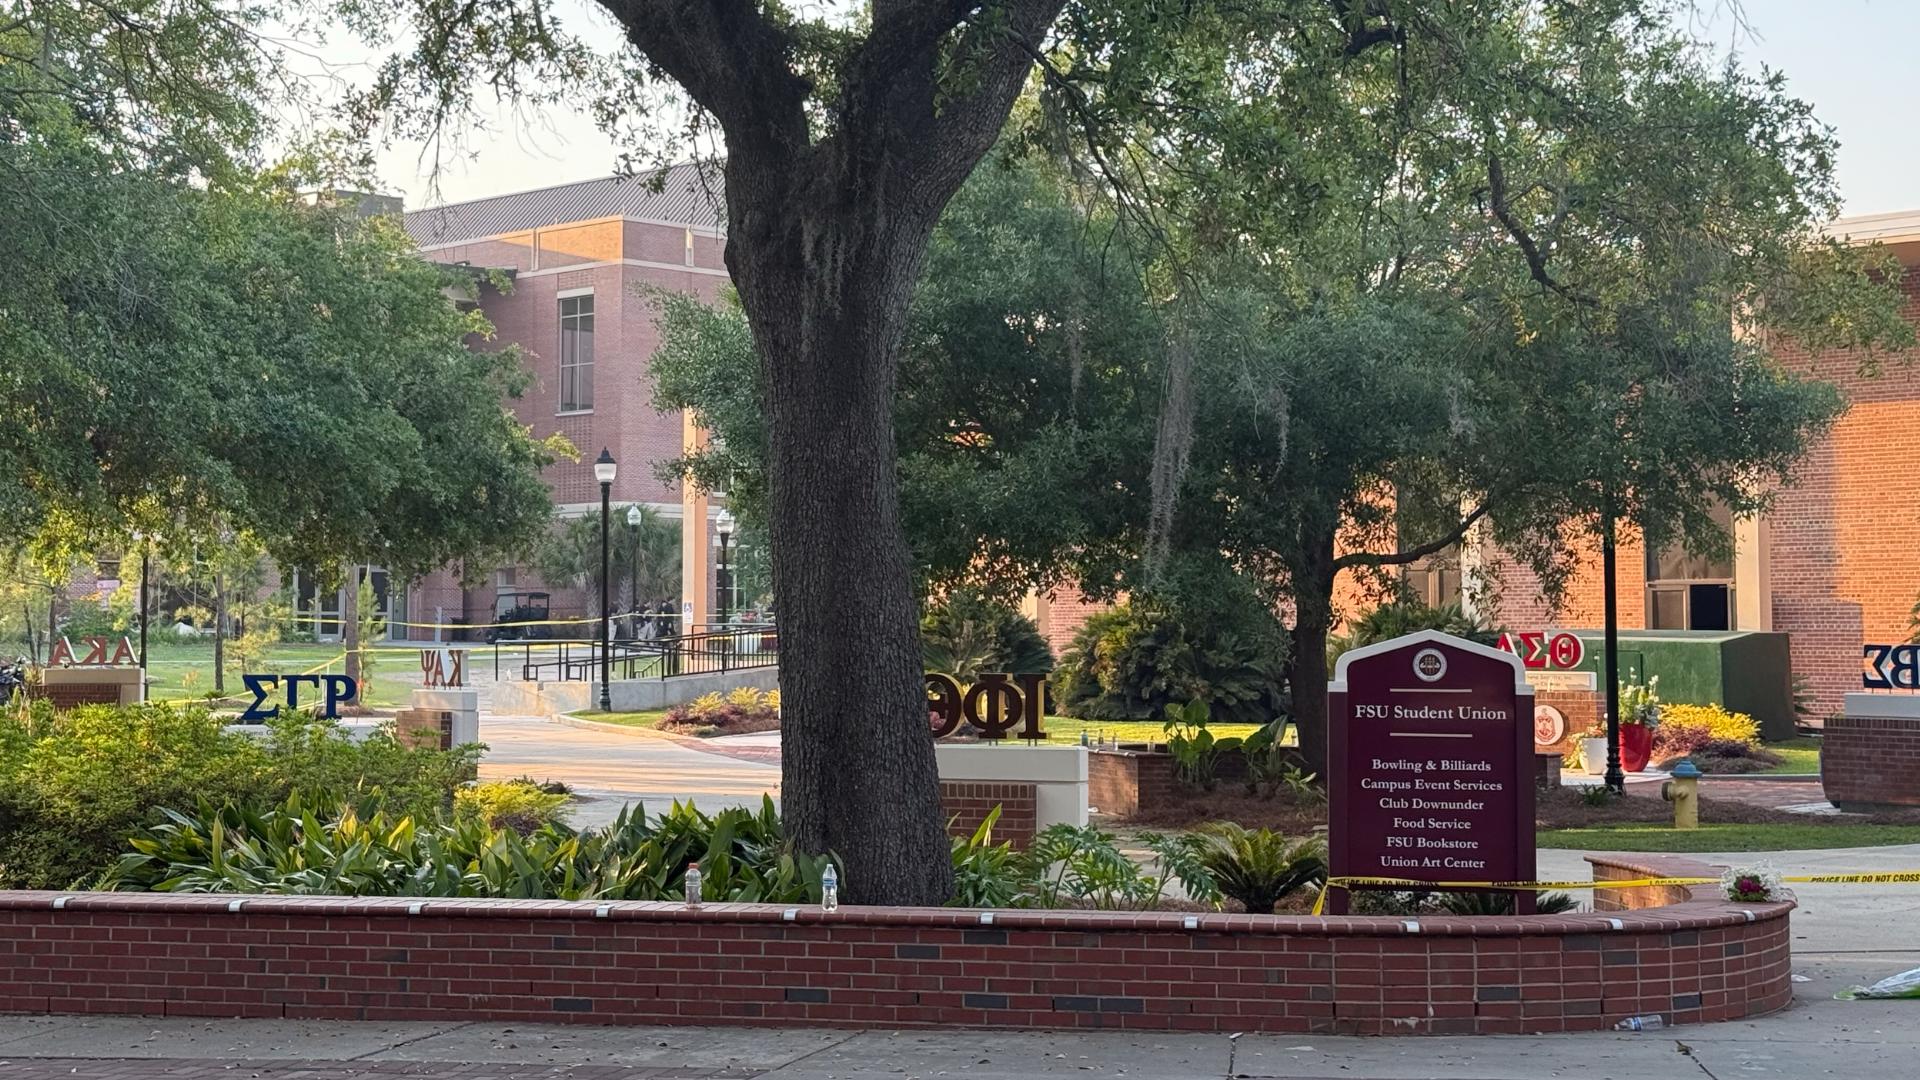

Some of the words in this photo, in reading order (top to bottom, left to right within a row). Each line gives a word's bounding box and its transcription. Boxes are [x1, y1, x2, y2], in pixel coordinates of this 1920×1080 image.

[1355, 704, 1388, 719] FSU
[1394, 705, 1454, 719] Student
[1458, 706, 1507, 720] Union
[1372, 758, 1422, 774] Bowling
[1426, 760, 1437, 771] &
[1440, 760, 1492, 772] Billiards
[1361, 777, 1411, 793] Campus
[1414, 779, 1450, 790] Event
[1453, 779, 1503, 791] Services
[1379, 797, 1409, 809] Club
[1412, 798, 1484, 810] Downunder
[1393, 817, 1425, 829] Food
[1428, 818, 1472, 830] Service
[1387, 836, 1413, 848] FSU
[1417, 837, 1479, 849] Bookstore
[1380, 855, 1418, 867] Union
[1421, 856, 1441, 868] Art
[1444, 857, 1486, 869] Center
[1811, 875, 1841, 883] POLICE
[1841, 875, 1861, 883] LINE
[1874, 874, 1891, 882] NOT
[1893, 873, 1920, 882] CROSS
